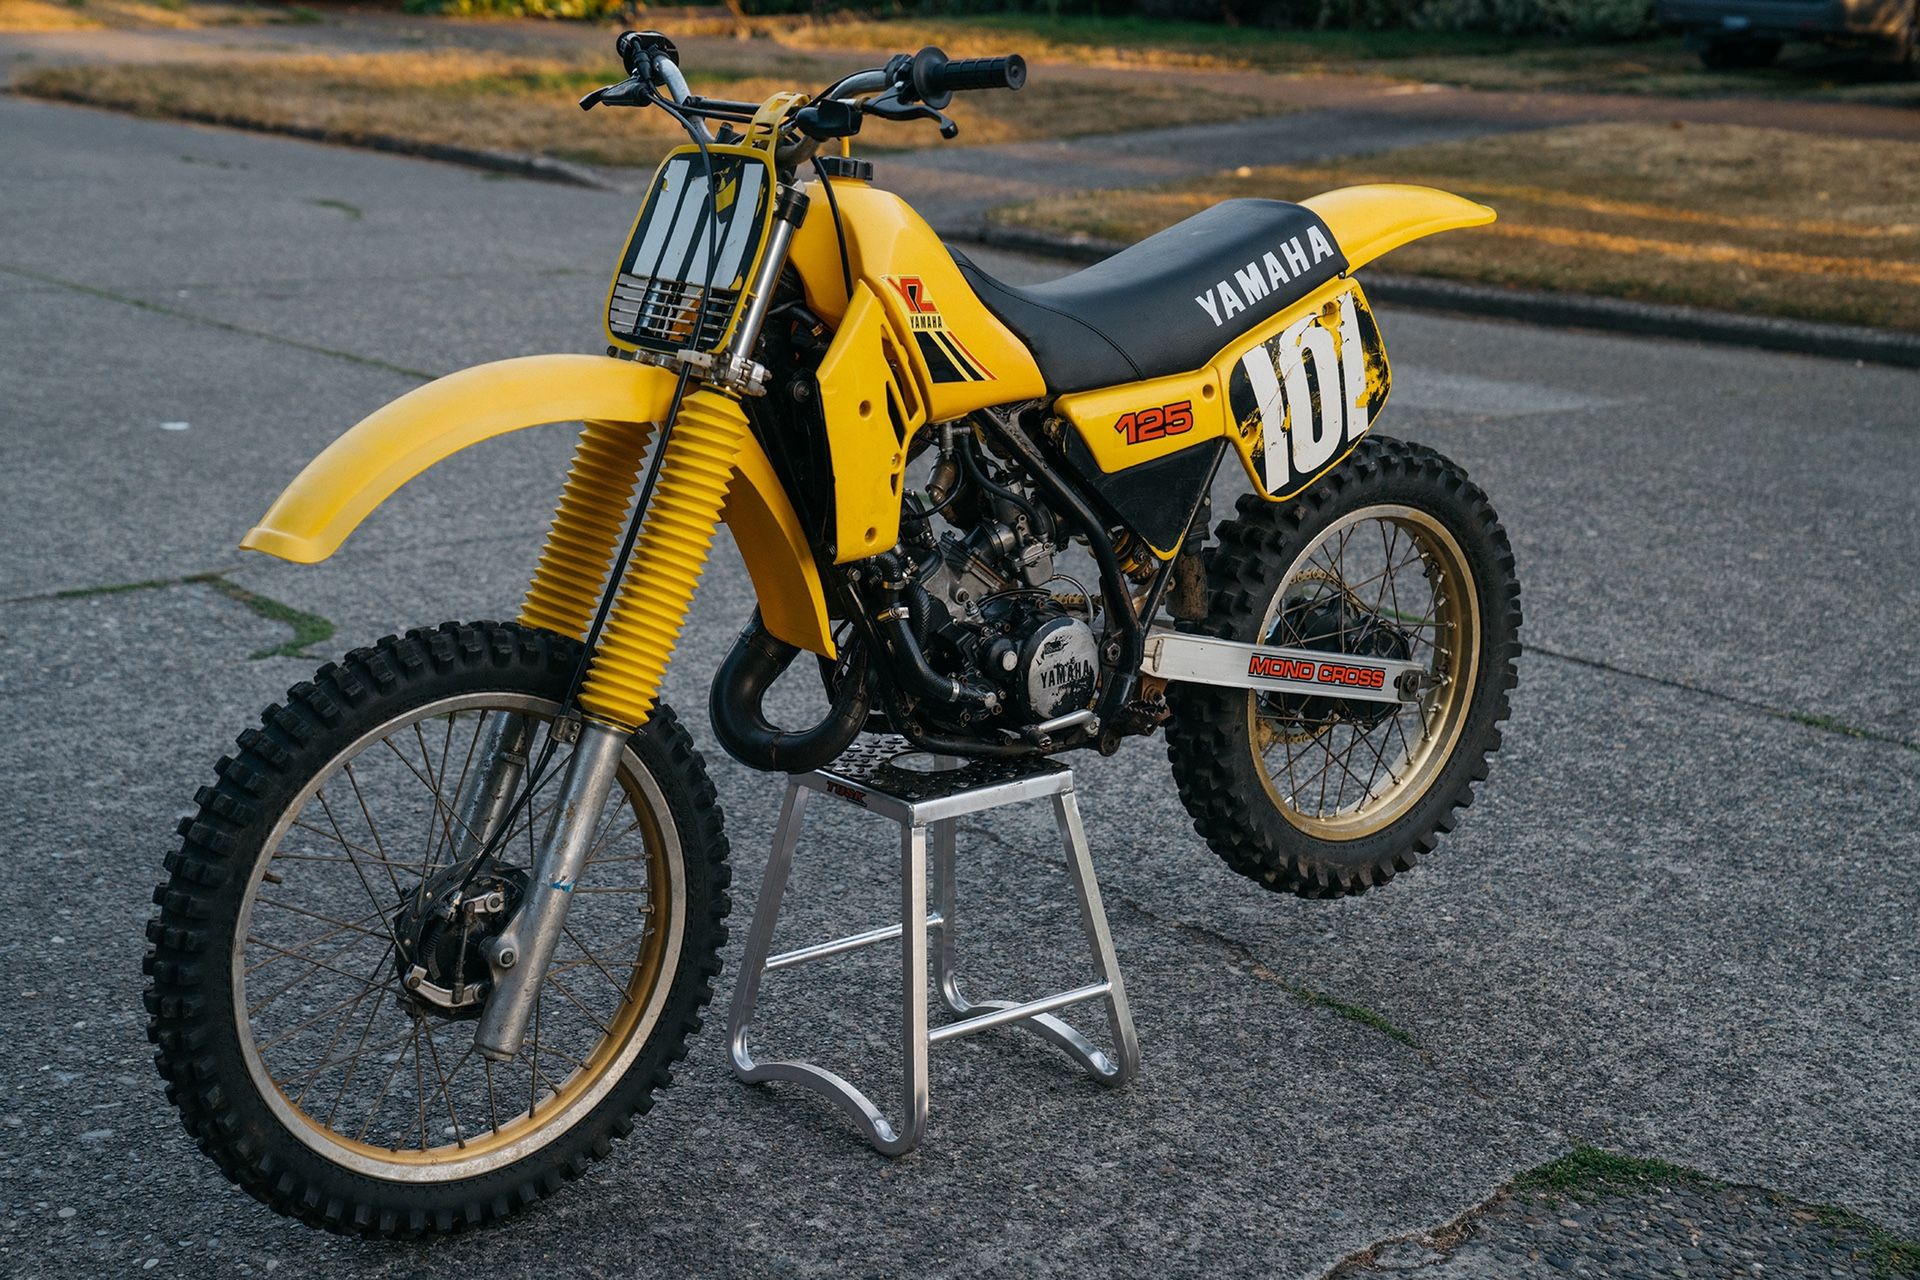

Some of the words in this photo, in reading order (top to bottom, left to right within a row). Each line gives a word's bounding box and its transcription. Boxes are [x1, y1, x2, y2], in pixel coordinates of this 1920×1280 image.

[1195, 225, 1334, 326] YAMAHA
[909, 315, 943, 329] YAMAHA
[1242, 291, 1369, 494] 101
[1114, 400, 1194, 445] 125
[1040, 659, 1090, 689] YAMAHA
[1248, 656, 1315, 680] MONO
[1318, 663, 1385, 688] CROSS
[826, 780, 867, 804] TUSK
